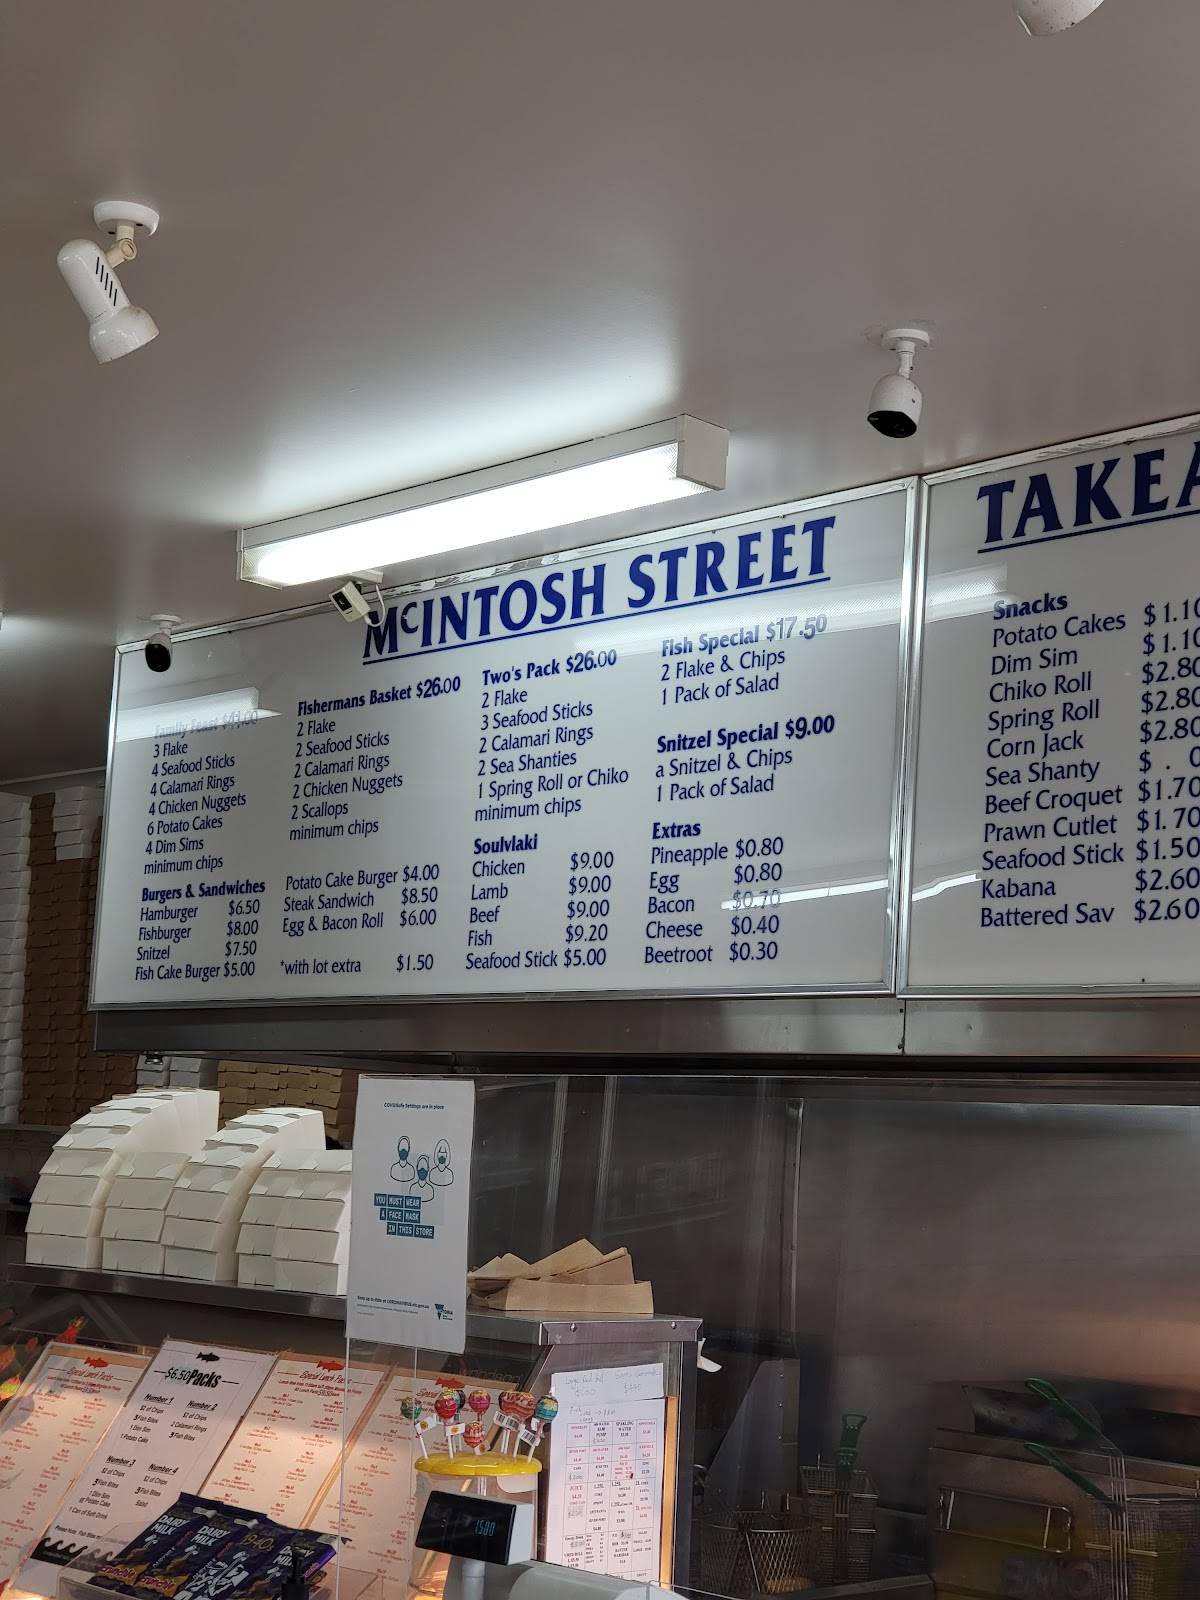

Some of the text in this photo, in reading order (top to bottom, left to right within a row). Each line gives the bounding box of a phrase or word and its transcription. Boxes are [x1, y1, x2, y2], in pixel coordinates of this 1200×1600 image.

[993, 592, 1068, 620] Snacks
[662, 616, 827, 657] Fish Special $17.50
[993, 623, 1058, 648] Potato
[1064, 613, 1126, 637] Cakes
[482, 649, 617, 686] Two's Pack $26.00
[660, 649, 786, 682] 2 Flake & Chips
[991, 654, 1032, 676] Dim
[1039, 648, 1078, 669] Sim
[662, 672, 779, 705] 1 Pack of Salad
[989, 656, 1200, 703] Chiko Roll $2.80
[297, 675, 461, 717] Fishermans Basket $26.00
[155, 722, 188, 738] Family
[190, 716, 218, 733] Feast
[657, 714, 835, 754] Snitzel Special $9.00
[987, 715, 1200, 760] Corn Jack $2.80
[153, 740, 189, 759] 3 Flake
[151, 753, 235, 777] 4 Seafood Sticks
[293, 754, 390, 779] 2 Calamari Rings
[477, 750, 577, 776] 2 Sea Shanties
[655, 748, 793, 778] a Snitzel & Chips
[479, 767, 629, 801] 1 Spring Roll or Chiko
[985, 776, 1200, 815] Beef Croquet $1.70
[148, 792, 246, 816] 4 Chicken Nuggets
[147, 815, 223, 836] 6 Potato Cakes
[652, 822, 701, 840] Extras
[984, 806, 1200, 843] Prawn Cutlet $1.70
[651, 836, 784, 867] Pineapple $0.80
[982, 836, 1200, 871] Seafood Stick $1.50
[144, 854, 223, 875] minimum chips
[285, 863, 440, 891] Potato Cake Burger $4.00
[472, 851, 614, 878] Chicken $9.00
[649, 862, 783, 894] Egg $0.80
[141, 879, 266, 905] Burgers & Sandwiches
[647, 889, 782, 914] Bacon $0.70
[140, 898, 260, 923] Hamburger $6.50
[282, 908, 437, 938] Egg & Bacon Roll $6.00
[980, 897, 1200, 928] Battered Sav $2.60
[138, 919, 259, 944] Fishburger $8.00
[465, 947, 607, 970] Seafood Stick $5.00
[135, 960, 256, 983] Fish Cake Burger $5.00
[375, 1195, 386, 1204] YOU
[388, 1210, 402, 1219] FACE
[405, 1213, 420, 1221] MASK
[389, 1224, 433, 1237] IN THIS STORE
[144, 1393, 169, 1403] Number
[186, 1400, 218, 1411] Number 2
[106, 1455, 137, 1468] Number 3
[148, 1463, 179, 1475] Number 4
[150, 1523, 178, 1536] MILK
[158, 1515, 191, 1528] DAIRY
[198, 1525, 232, 1539] DAIRY
[191, 1535, 219, 1547] MILK
[279, 1545, 315, 1558] DAY
